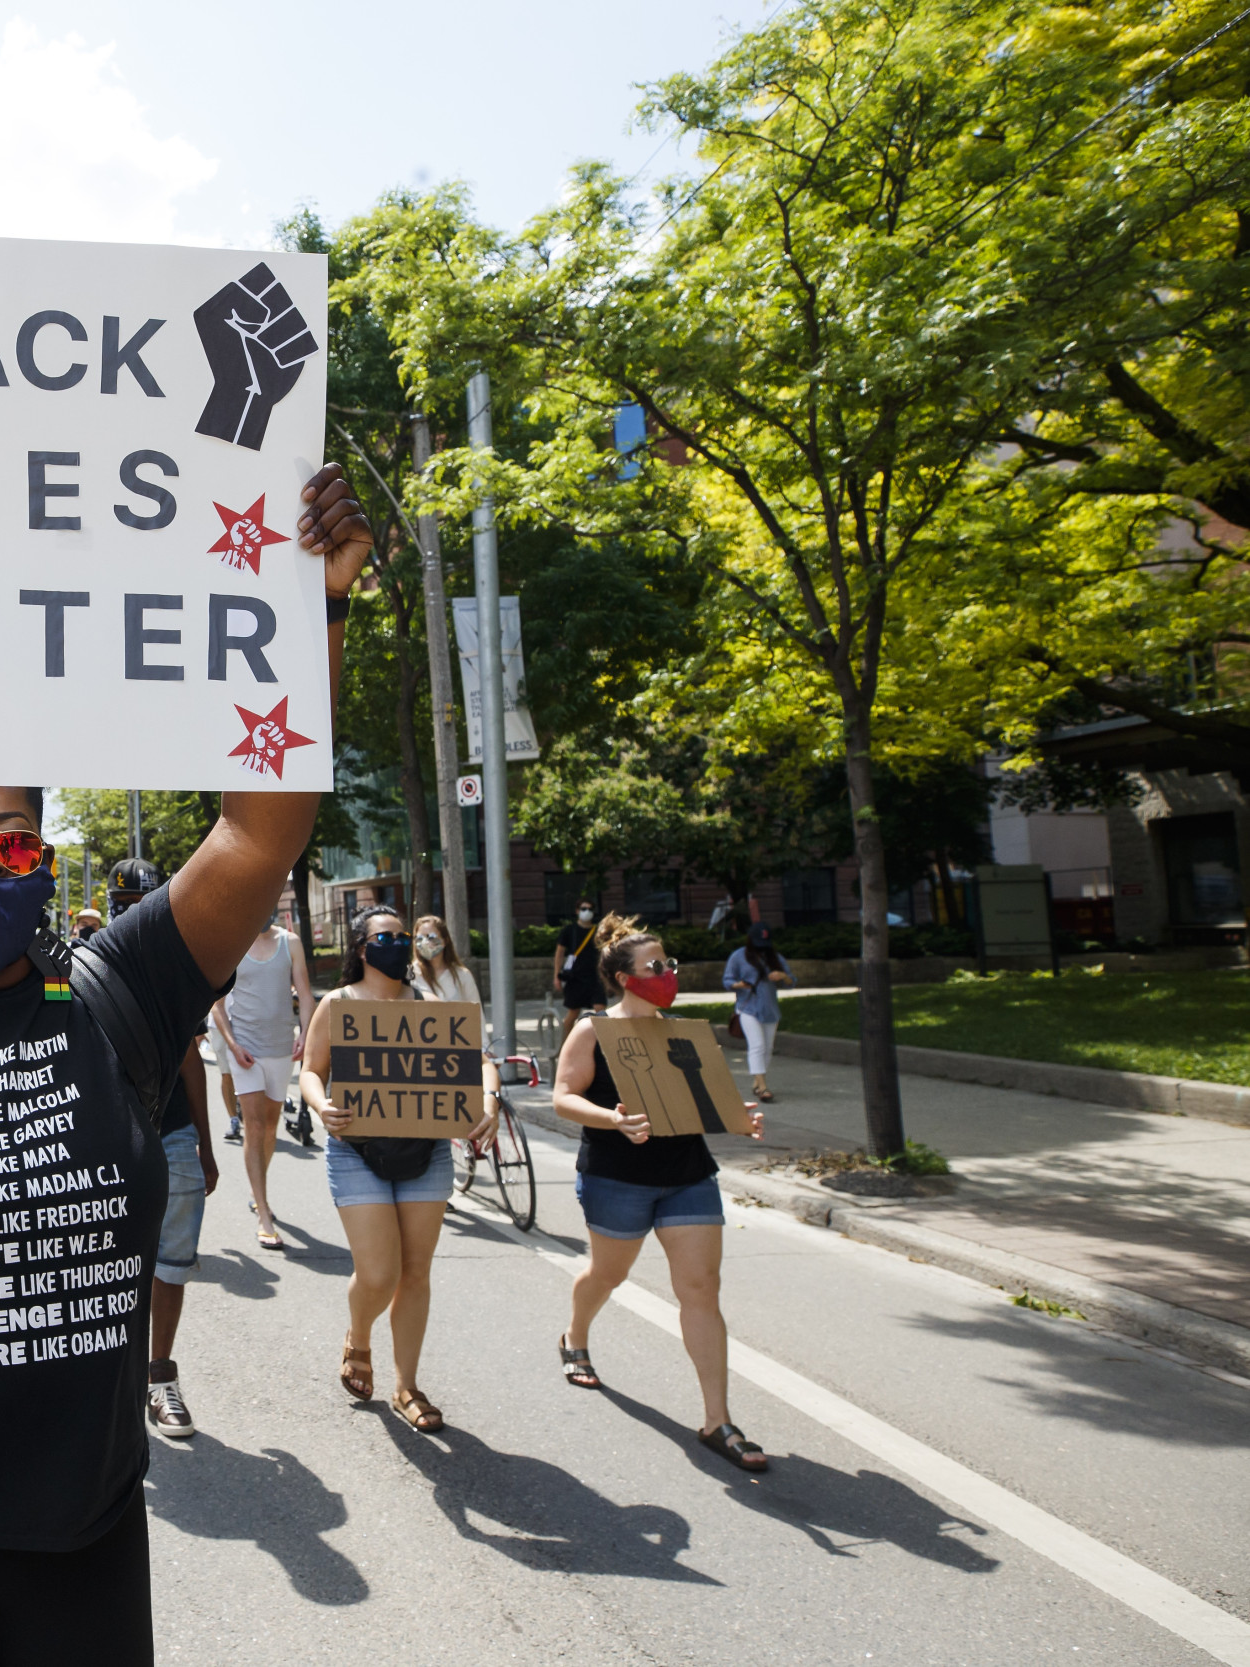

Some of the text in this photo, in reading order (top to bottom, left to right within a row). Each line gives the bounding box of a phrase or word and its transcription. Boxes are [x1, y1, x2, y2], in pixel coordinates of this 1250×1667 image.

[342, 1013, 471, 1046] BLACK
[19, 1032, 68, 1061] MARTIN
[358, 1052, 460, 1078] LIVES
[8, 1083, 80, 1122] MALCOLM
[344, 1089, 473, 1123] MATTER
[14, 1111, 75, 1144] GARVEY
[22, 1142, 70, 1170] MAYA
[25, 1169, 93, 1199] MADAM
[97, 1163, 125, 1187] C.J.
[36, 1196, 128, 1230] FREDERICK
[26, 1238, 63, 1261] LIKE
[69, 1231, 116, 1256] W.E.B.
[20, 1271, 56, 1297] LIKE
[60, 1255, 142, 1291] THURGOOD
[69, 1297, 104, 1323] LIKE
[32, 1338, 68, 1362] LIKE
[71, 1323, 128, 1356] OBAMA
